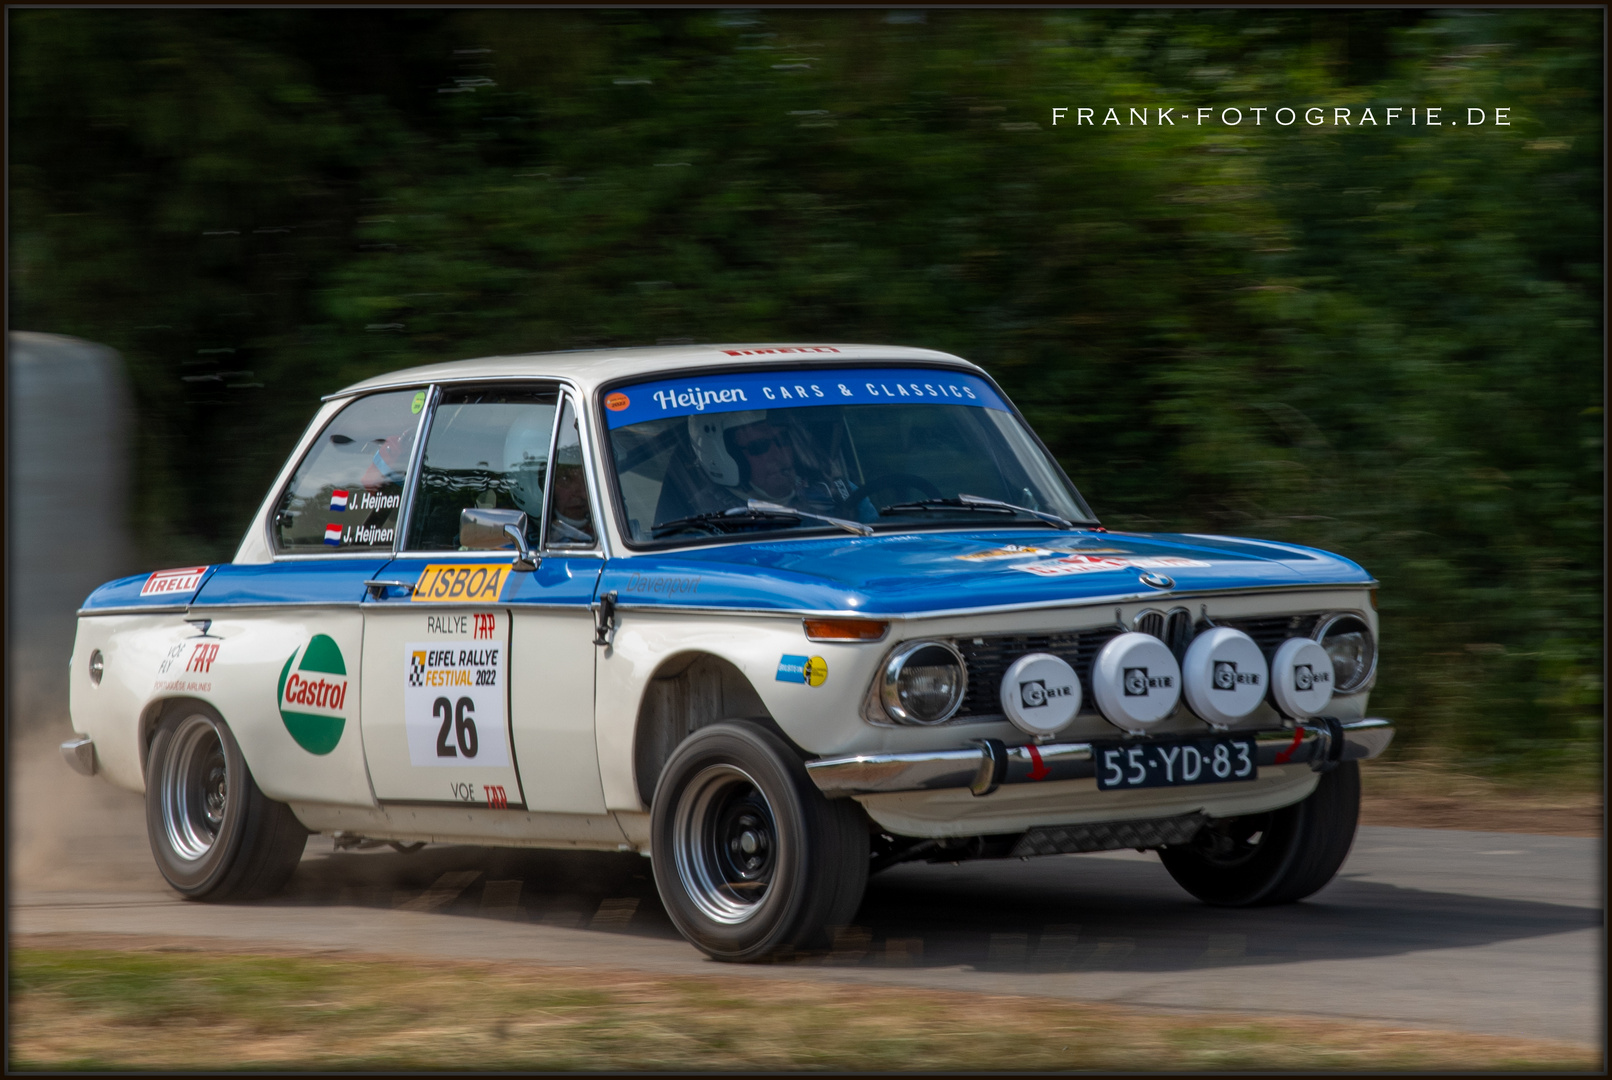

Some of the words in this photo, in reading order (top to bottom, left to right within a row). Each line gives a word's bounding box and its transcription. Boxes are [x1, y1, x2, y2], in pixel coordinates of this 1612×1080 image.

[653, 386, 747, 411] Heijnen
[763, 384, 825, 400] CARS
[838, 383, 853, 397] &
[866, 383, 977, 400] CLASSICS
[349, 493, 358, 510] J.
[361, 492, 399, 512] Heijnen
[343, 526, 351, 543] J.
[355, 525, 394, 545] Heijnen
[142, 566, 208, 594] PIRELLI
[415, 567, 503, 598] LISBOA
[626, 572, 701, 598] Davenport
[427, 616, 467, 633] RALLYE
[473, 613, 496, 639] TAP
[185, 644, 220, 673] TAP
[428, 650, 456, 667] EIFEL
[458, 649, 498, 667] RALLYE
[425, 669, 473, 687] FESTIVAL
[475, 669, 497, 686] 2022
[285, 673, 347, 710] Castrol
[432, 696, 479, 759] 26
[450, 782, 475, 802] VOE
